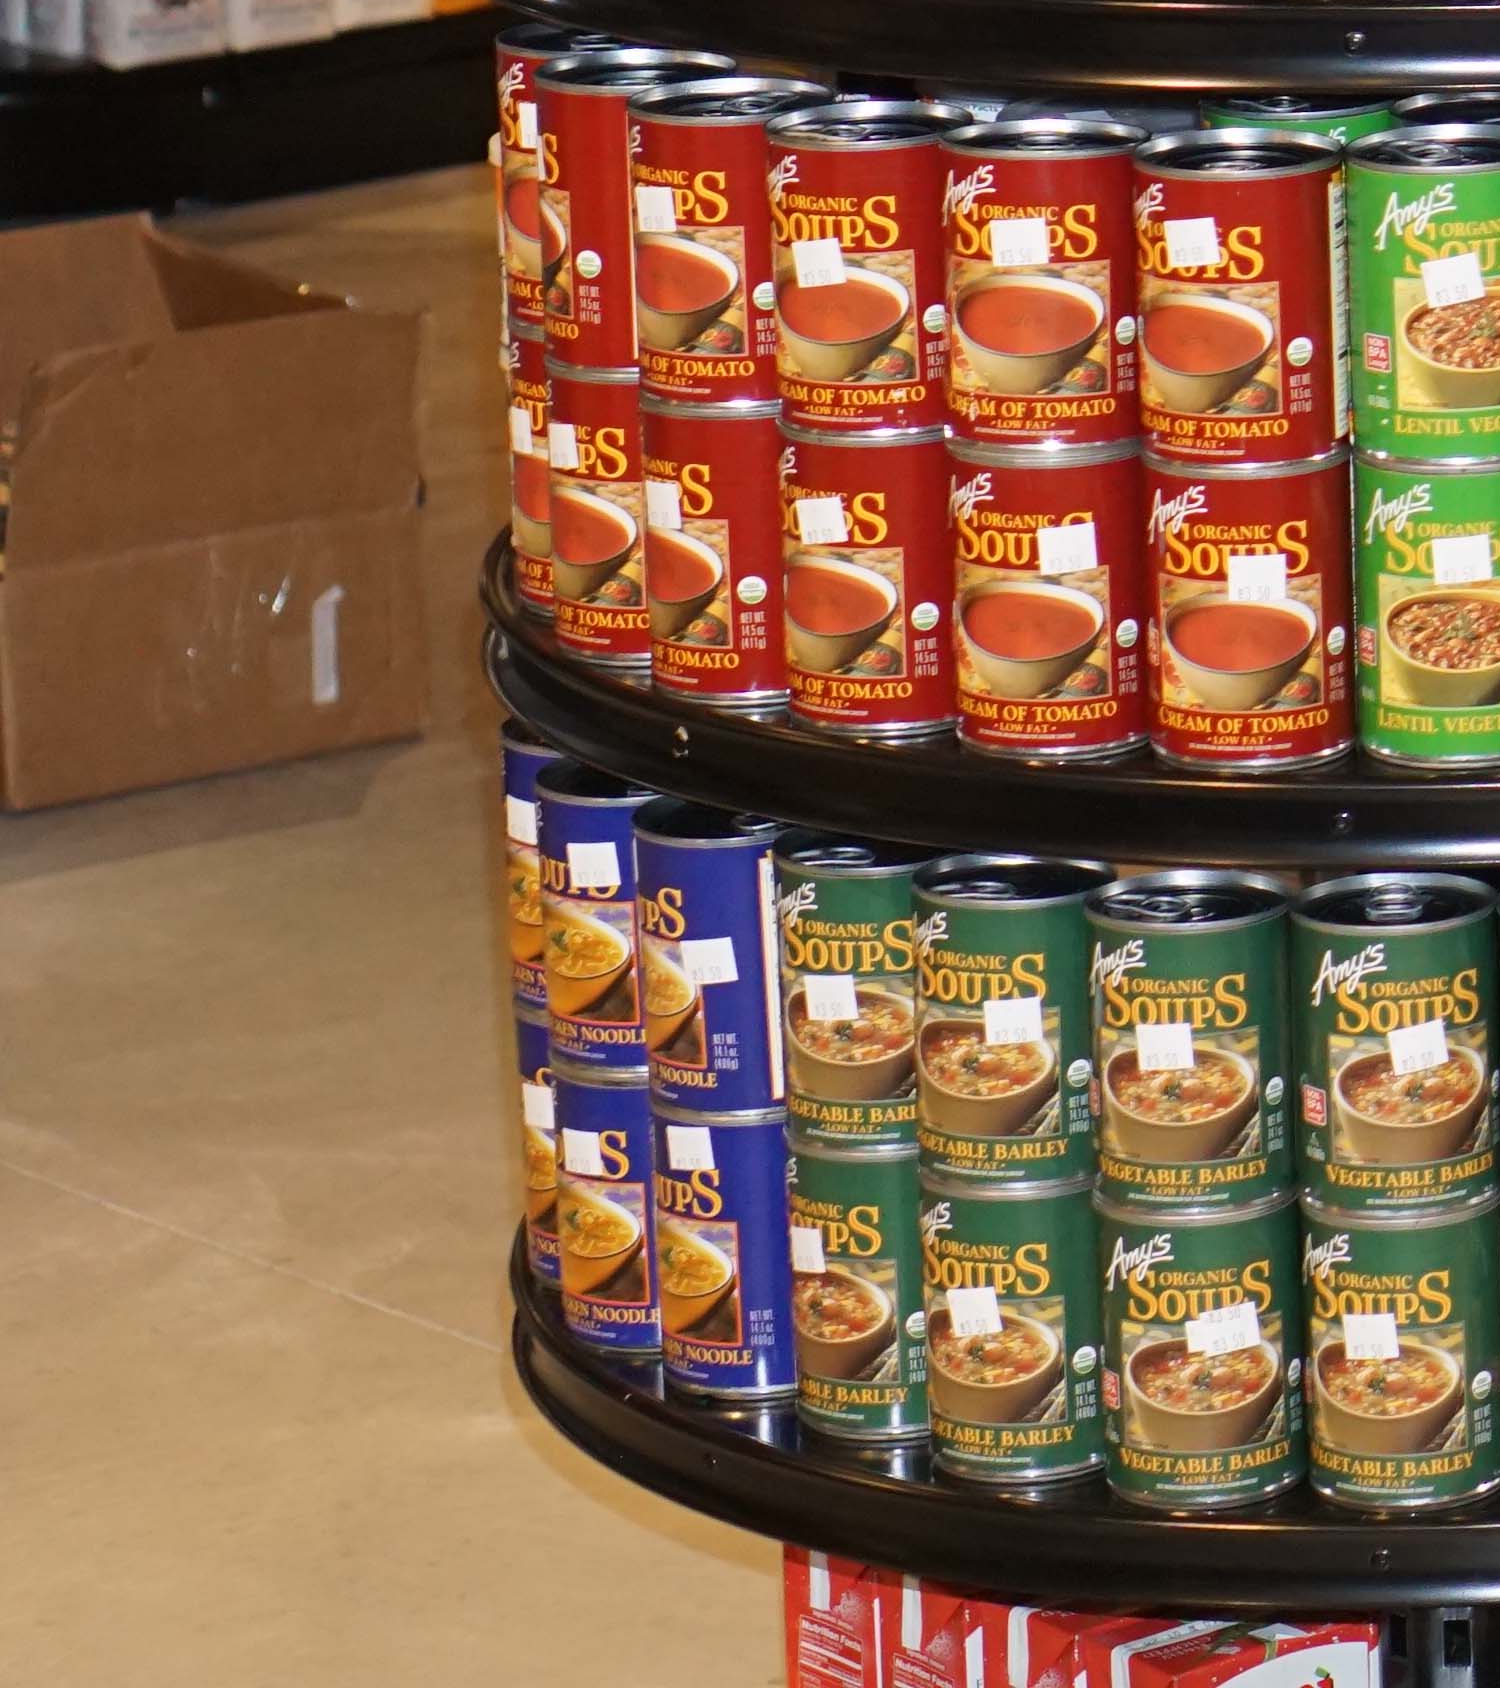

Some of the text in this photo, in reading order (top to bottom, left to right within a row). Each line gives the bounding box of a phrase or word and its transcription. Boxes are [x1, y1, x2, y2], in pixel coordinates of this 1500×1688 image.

[839, 383, 926, 407] TOMATO
[1147, 486, 1206, 542] Amy's
[1190, 523, 1273, 541] ORGANIC
[1159, 707, 1330, 734] CREAM OF TOMATO
[659, 1068, 718, 1090] NOODLE
